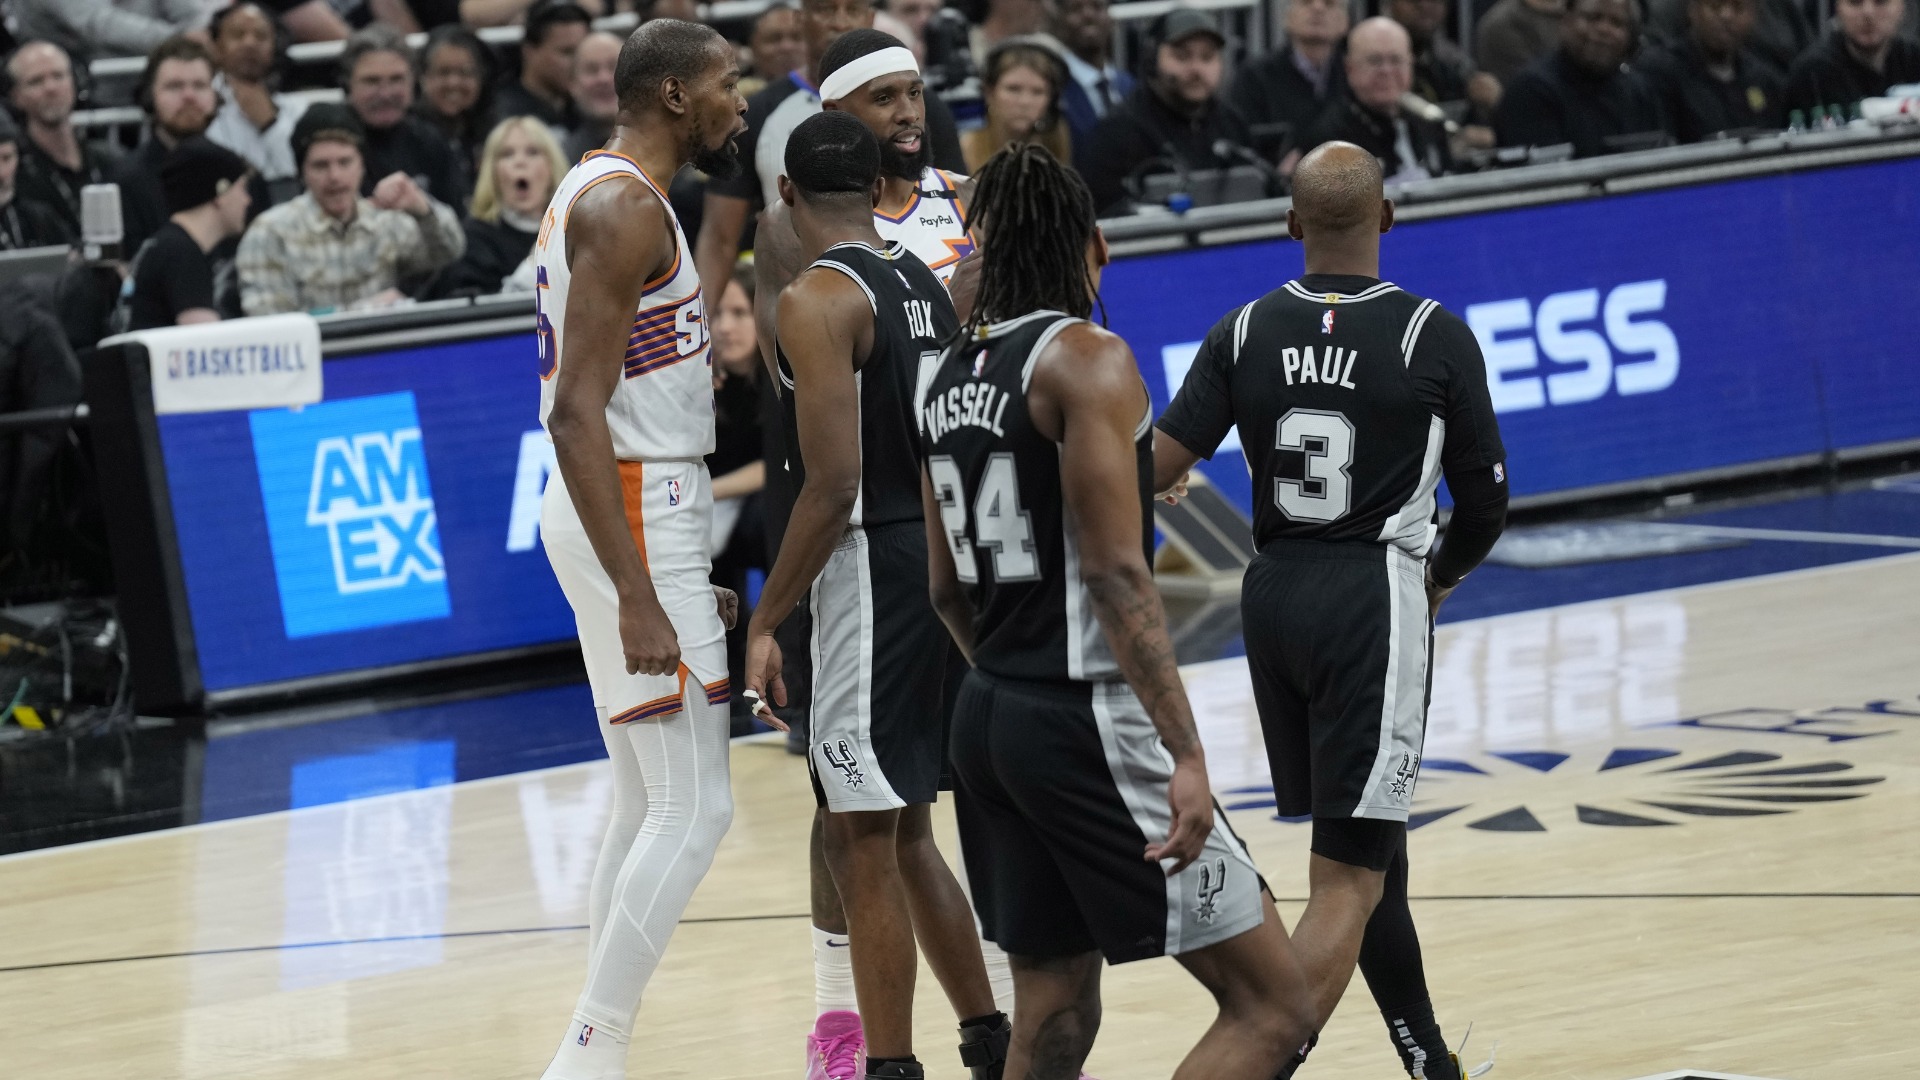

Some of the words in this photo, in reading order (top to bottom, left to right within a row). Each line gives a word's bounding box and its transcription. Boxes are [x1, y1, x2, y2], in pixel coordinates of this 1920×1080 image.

[919, 215, 954, 228] PayPal
[903, 299, 937, 340] FOX
[186, 342, 306, 378] BASKETBALL
[1281, 346, 1358, 390] PAUL
[925, 383, 1010, 444] VASSELL
[306, 428, 433, 526] AM
[1274, 407, 1356, 523] 3
[929, 452, 1043, 584] 24
[329, 506, 445, 595] EX
